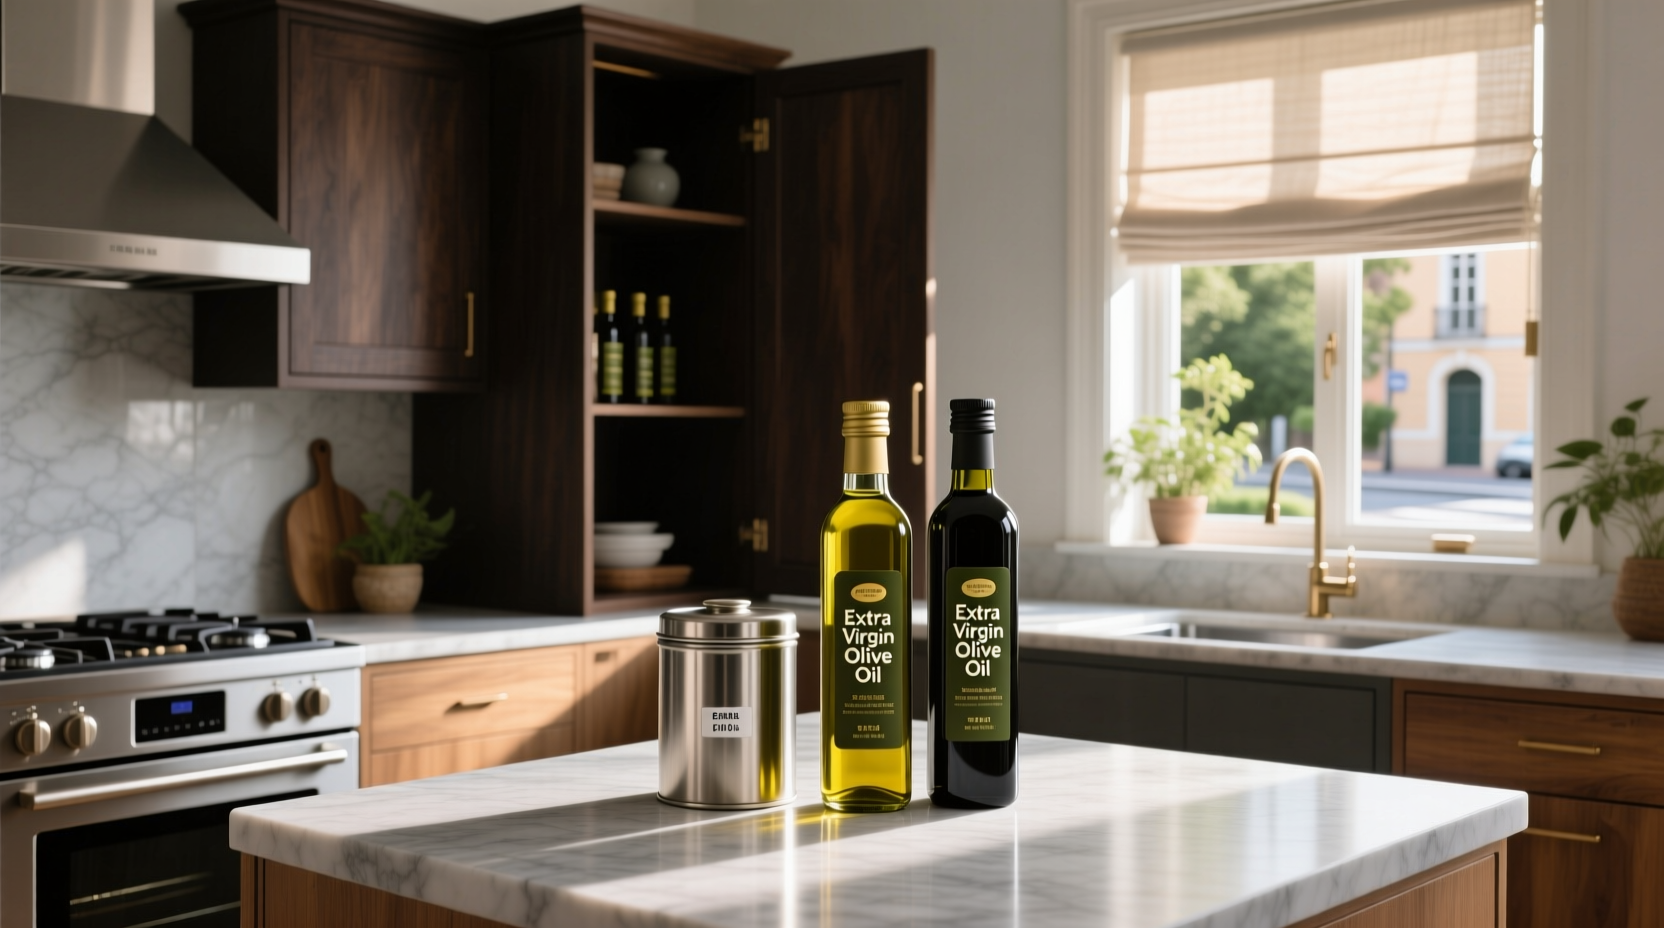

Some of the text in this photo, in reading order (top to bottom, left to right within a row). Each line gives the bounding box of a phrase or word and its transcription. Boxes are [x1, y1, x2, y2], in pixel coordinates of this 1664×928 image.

[844, 609, 891, 626] Extra
[955, 604, 1000, 621] Extra
[842, 628, 895, 648] Virgin
[953, 623, 1004, 643] Virgin
[844, 647, 893, 664] Olive
[955, 641, 1002, 659] Olive
[855, 666, 881, 683] Oil
[965, 660, 991, 677] Oil
